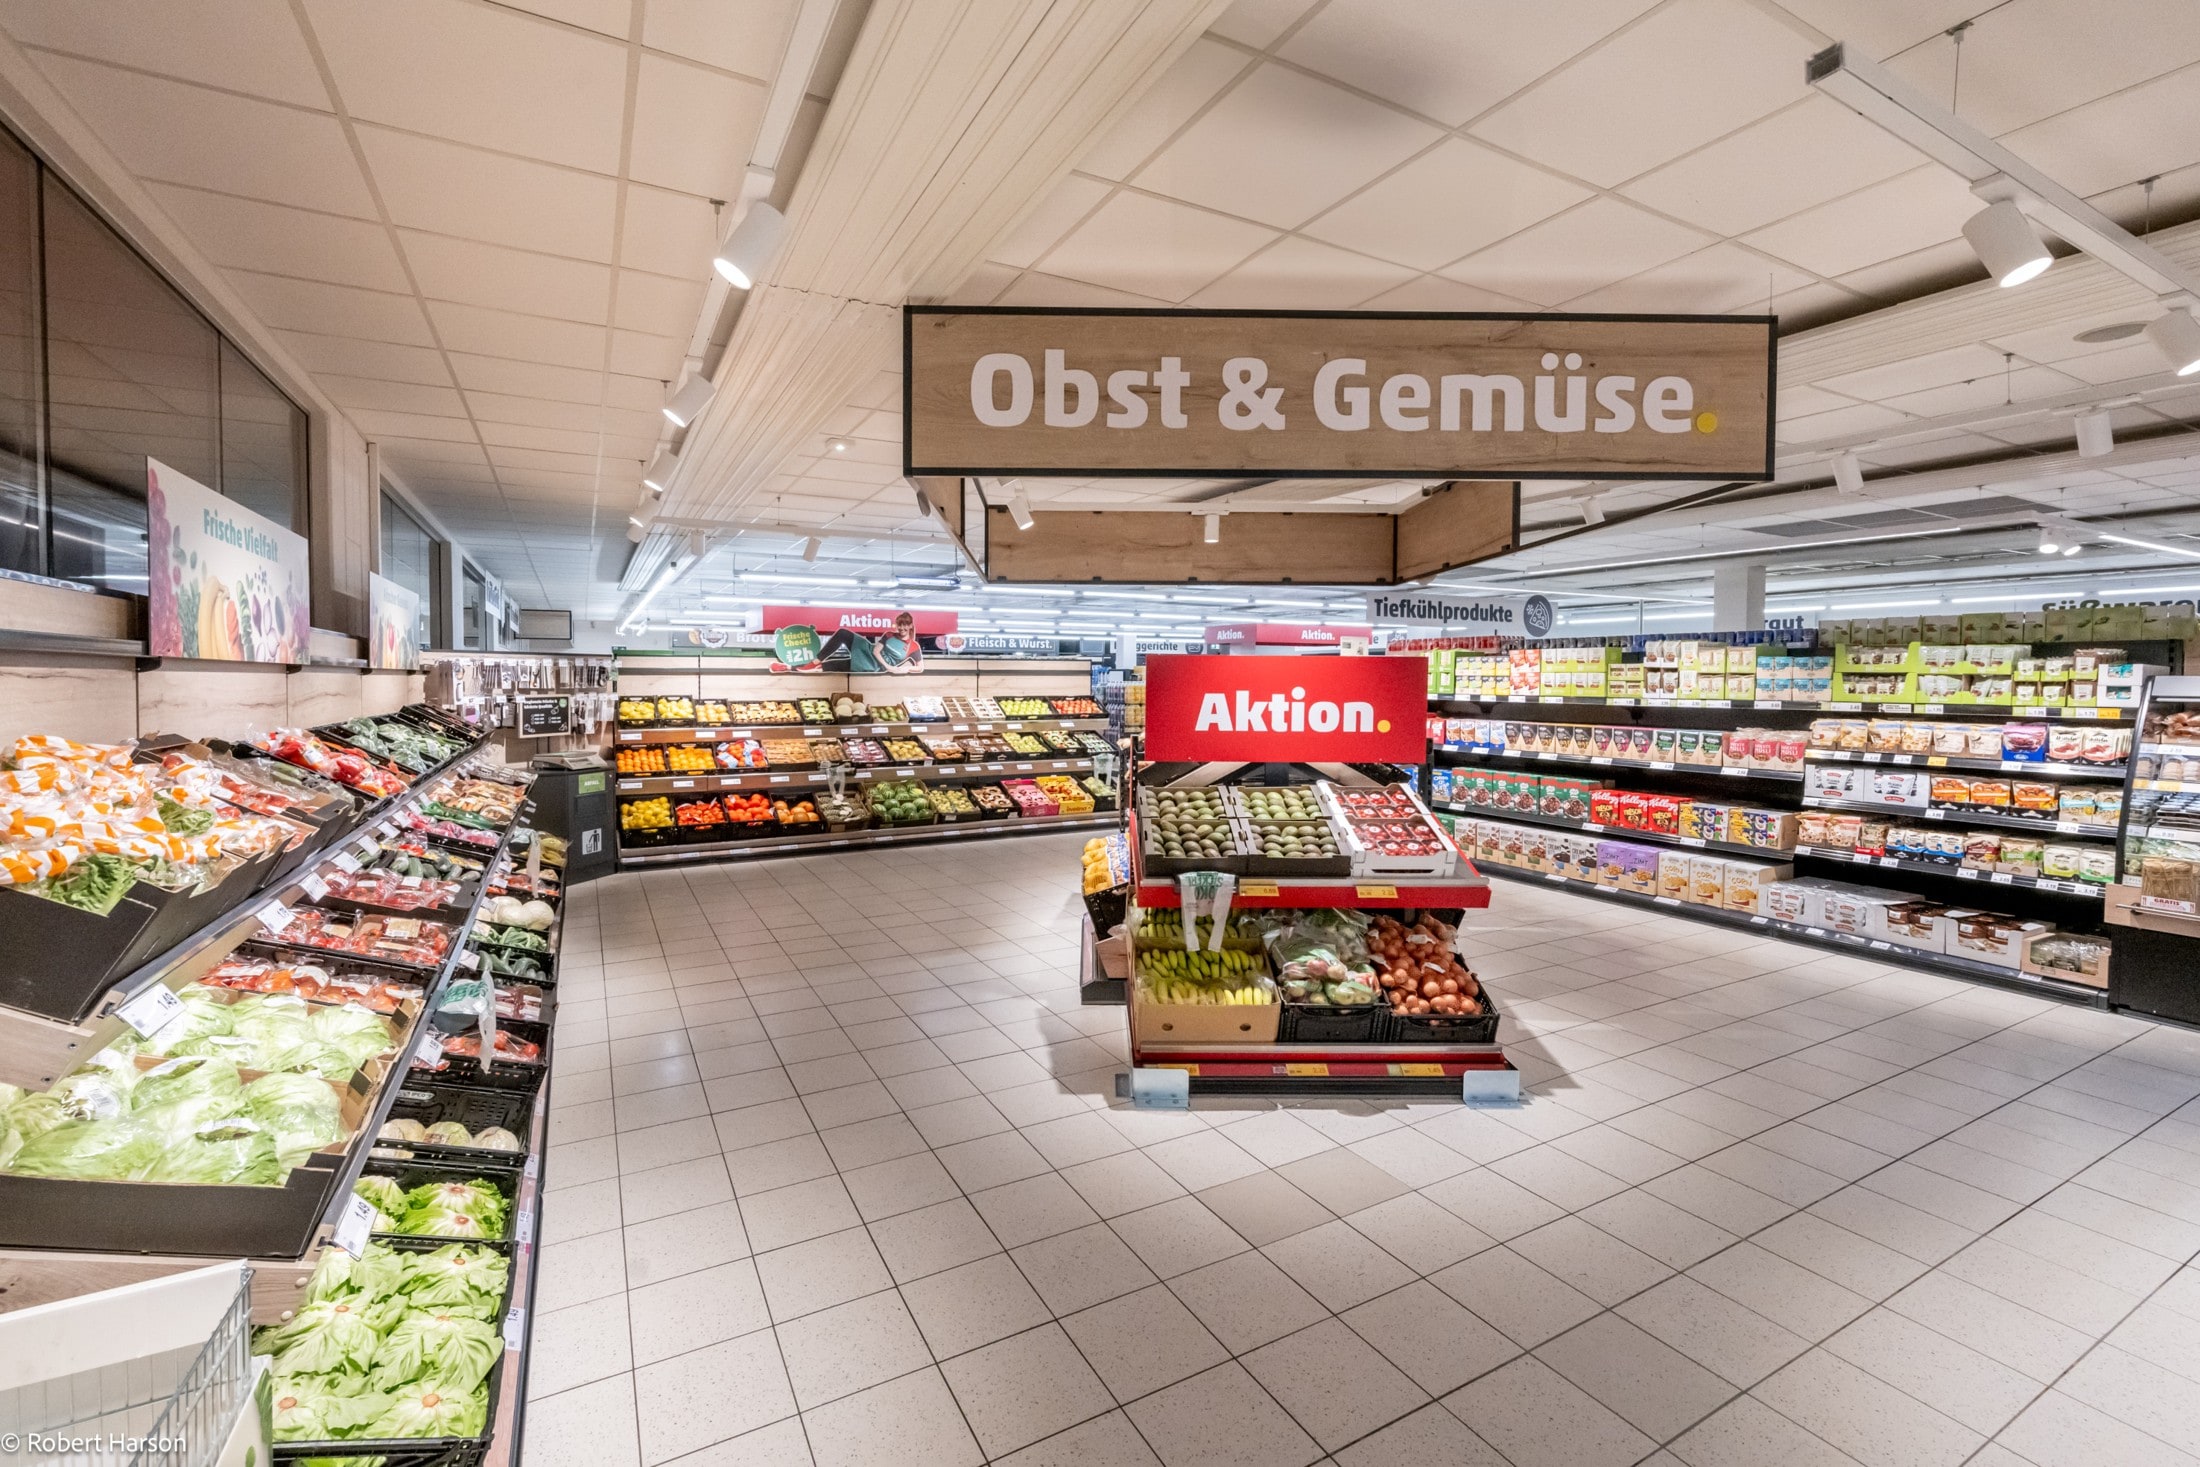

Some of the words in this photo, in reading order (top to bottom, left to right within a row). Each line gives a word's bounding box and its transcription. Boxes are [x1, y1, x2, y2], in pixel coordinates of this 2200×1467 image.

[970, 348, 1192, 430] Obst
[1219, 357, 1286, 431] &
[1314, 352, 1718, 434] Gemüse.
[203, 508, 243, 549] Frische
[244, 526, 278, 563] Vielfalt
[1374, 598, 1513, 624] Tiefkühlprodukte
[840, 614, 896, 628] Aktion.
[1765, 616, 1804, 630] aut
[969, 637, 1006, 648] Fleisch
[1009, 637, 1017, 648] &
[1019, 637, 1053, 649] Wurst.
[1216, 629, 1245, 641] Aktion.
[1301, 629, 1336, 641] Aktion.
[1114, 641, 1178, 653] ggerichte
[1195, 686, 1391, 733] Aktion.
[156, 992, 178, 1011] 1.49
[354, 1200, 371, 1221] 1.49
